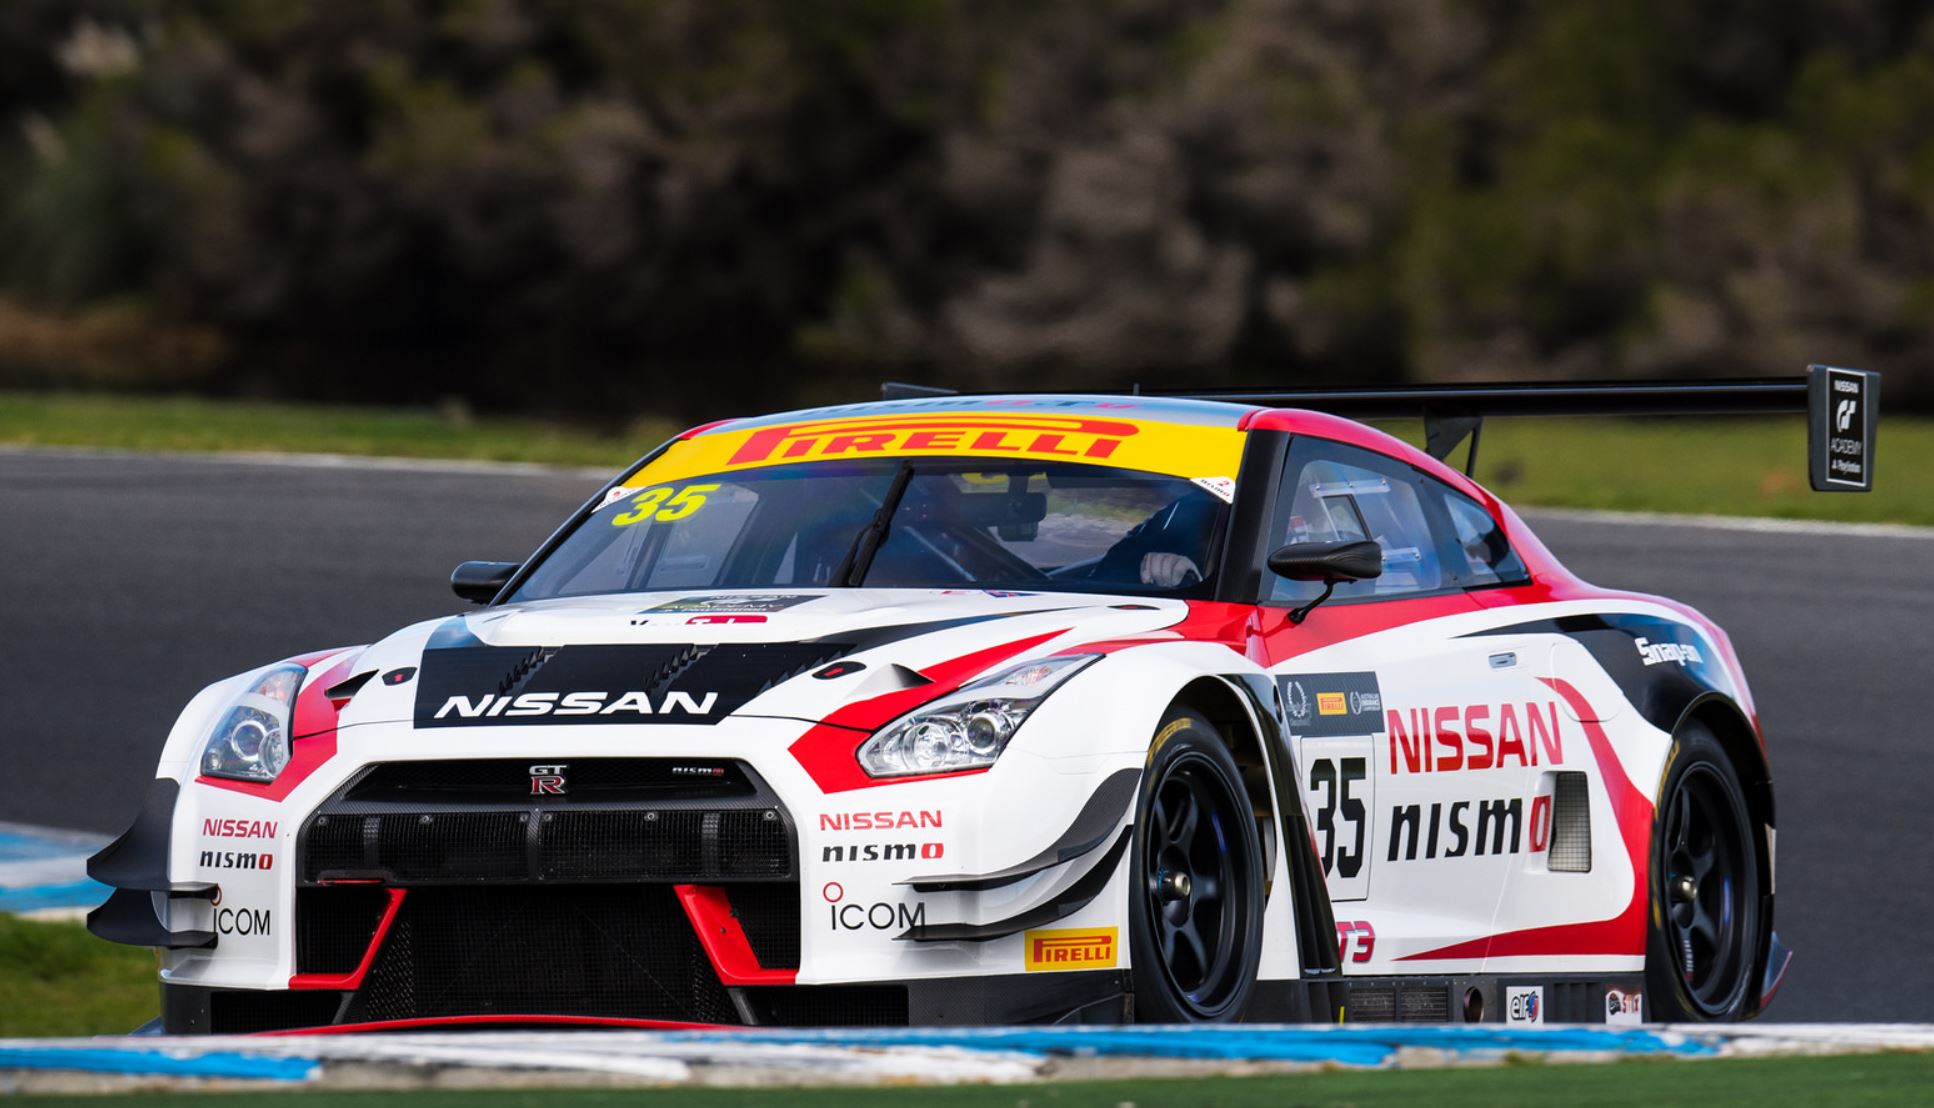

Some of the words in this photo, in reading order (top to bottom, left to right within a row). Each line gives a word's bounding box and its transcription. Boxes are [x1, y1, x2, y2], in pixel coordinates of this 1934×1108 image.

[726, 414, 1140, 466] PIRELLI
[611, 483, 721, 526] 35
[434, 691, 719, 719] NISSAN
[1387, 701, 1564, 775] NISSAN
[529, 765, 568, 776] GT
[530, 775, 568, 795] R
[203, 818, 278, 839] NISSAN
[819, 810, 943, 831] NISSAN
[1310, 757, 1366, 878] 35
[1387, 795, 1552, 862] nismo
[200, 850, 273, 870] nismo
[822, 842, 944, 862] nismo
[1033, 935, 1112, 963] PIRELLI
[1336, 920, 1375, 963] T3
